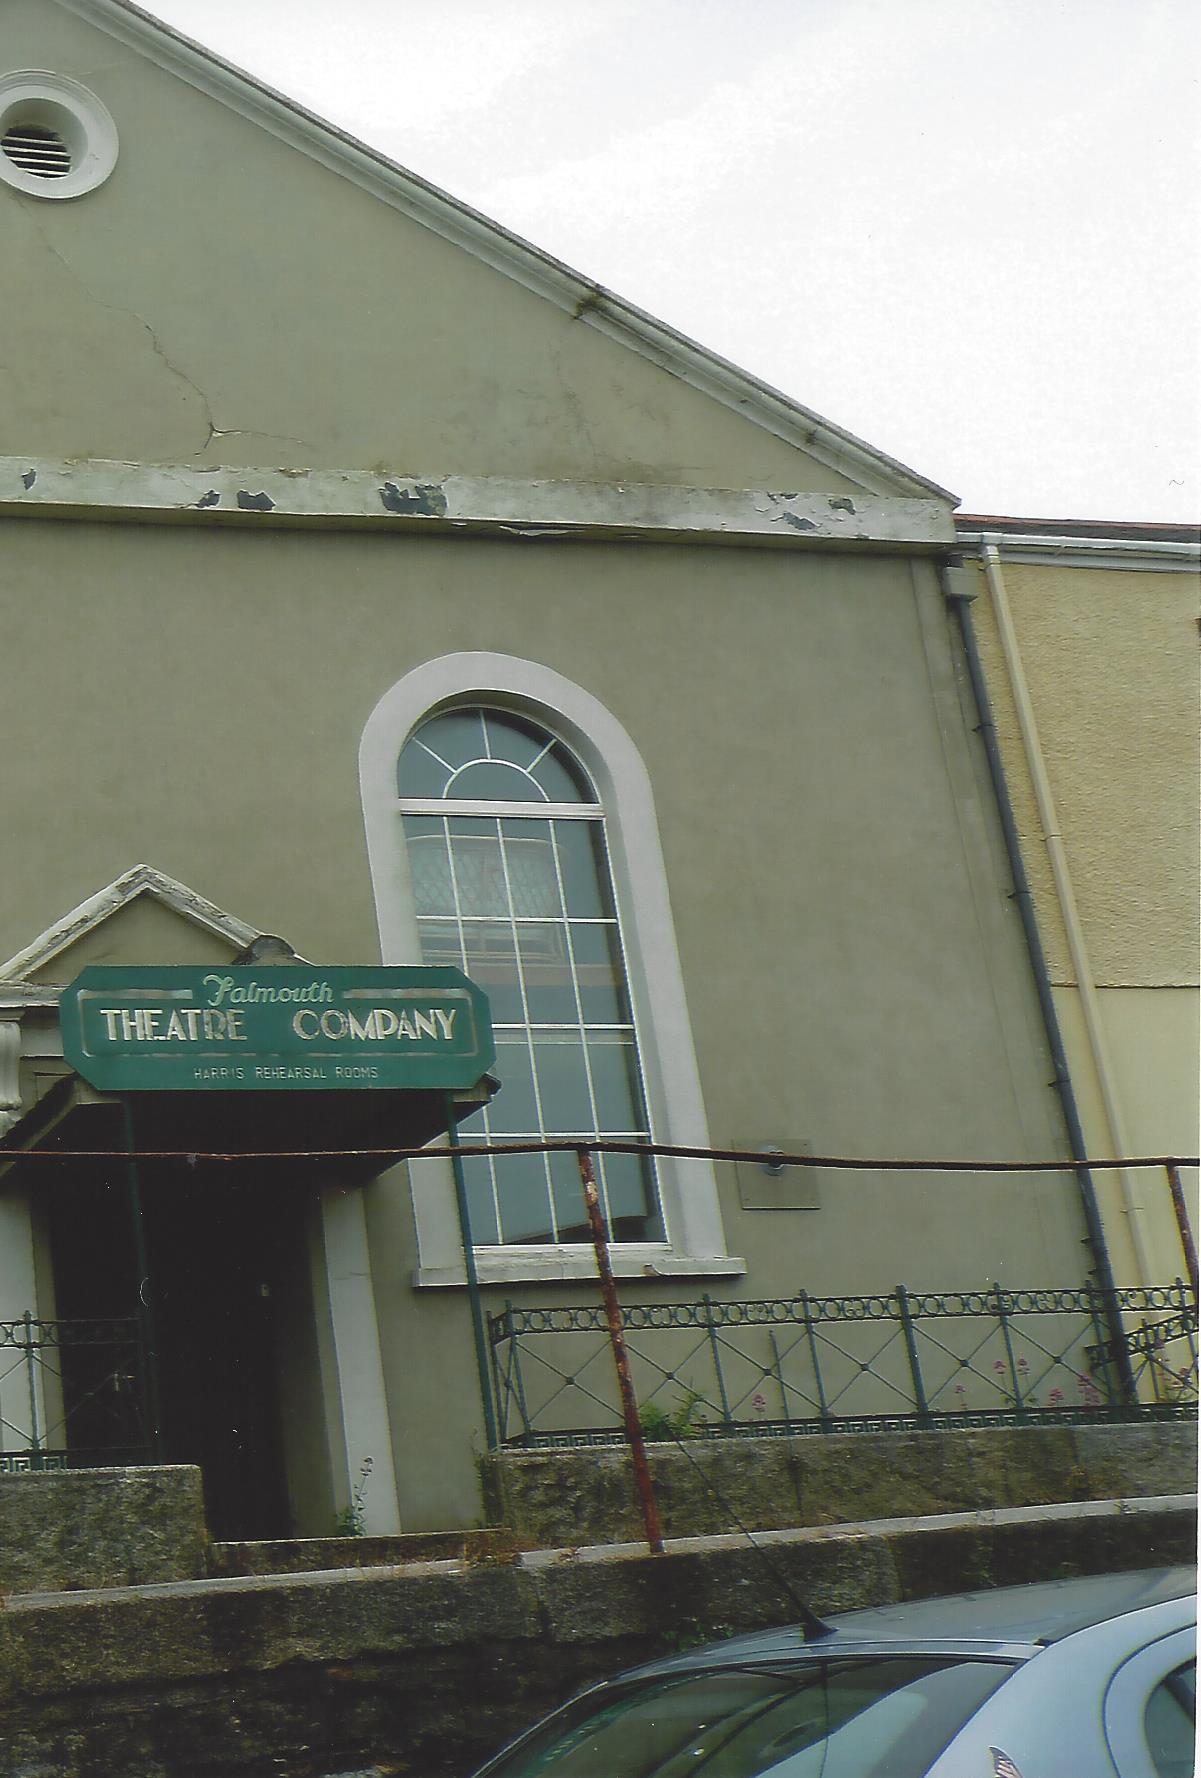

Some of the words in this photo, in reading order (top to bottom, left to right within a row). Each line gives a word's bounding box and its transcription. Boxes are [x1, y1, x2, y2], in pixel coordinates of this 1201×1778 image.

[203, 974, 334, 1006] Falmouth
[100, 1009, 248, 1041] THEATRE
[293, 1008, 457, 1040] COMPANY
[194, 1067, 244, 1079] HARRIS
[255, 1067, 326, 1079] REHEARSAL
[335, 1067, 378, 1079] ROOMS
